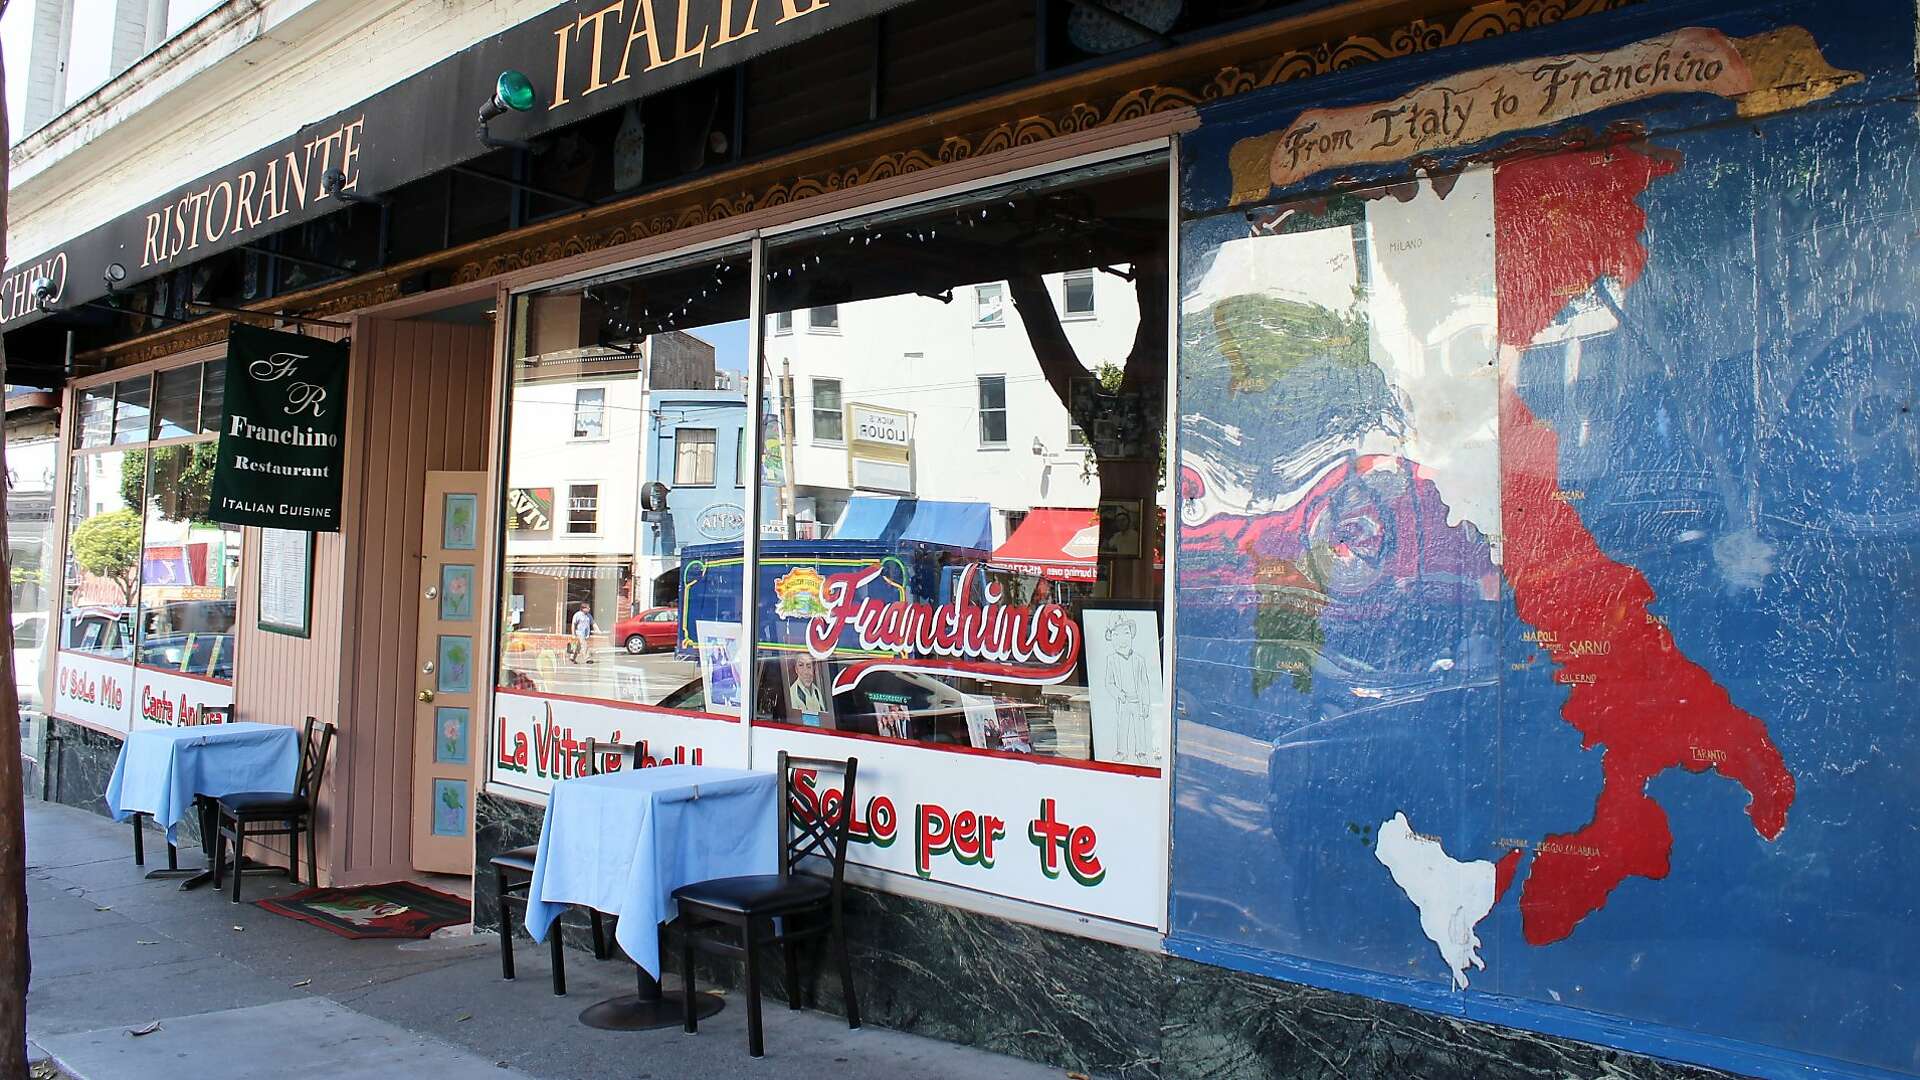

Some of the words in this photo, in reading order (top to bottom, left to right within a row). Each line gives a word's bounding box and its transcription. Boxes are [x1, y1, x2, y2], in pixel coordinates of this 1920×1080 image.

[1284, 120, 1354, 170] From
[1370, 90, 1474, 151] Italy
[1492, 86, 1518, 119] to
[1532, 50, 1723, 116] Franchino
[140, 114, 365, 269] RISTORANTE
[1389, 238, 1424, 252] MILANO
[249, 352, 309, 382] F
[283, 381, 327, 418] R
[228, 414, 338, 448] Franchino
[234, 455, 329, 478] Restaurant
[222, 497, 275, 514] ITALIAN
[279, 504, 332, 518] CUISINE
[805, 562, 1080, 690] Franchino
[1646, 614, 1668, 625] BARI
[1522, 631, 1558, 642] NAPOLI
[1569, 640, 1611, 656] SARNO
[1560, 673, 1597, 683] SALERNO
[498, 717, 528, 774] La
[915, 803, 1006, 879] per
[1028, 798, 1106, 887] te
